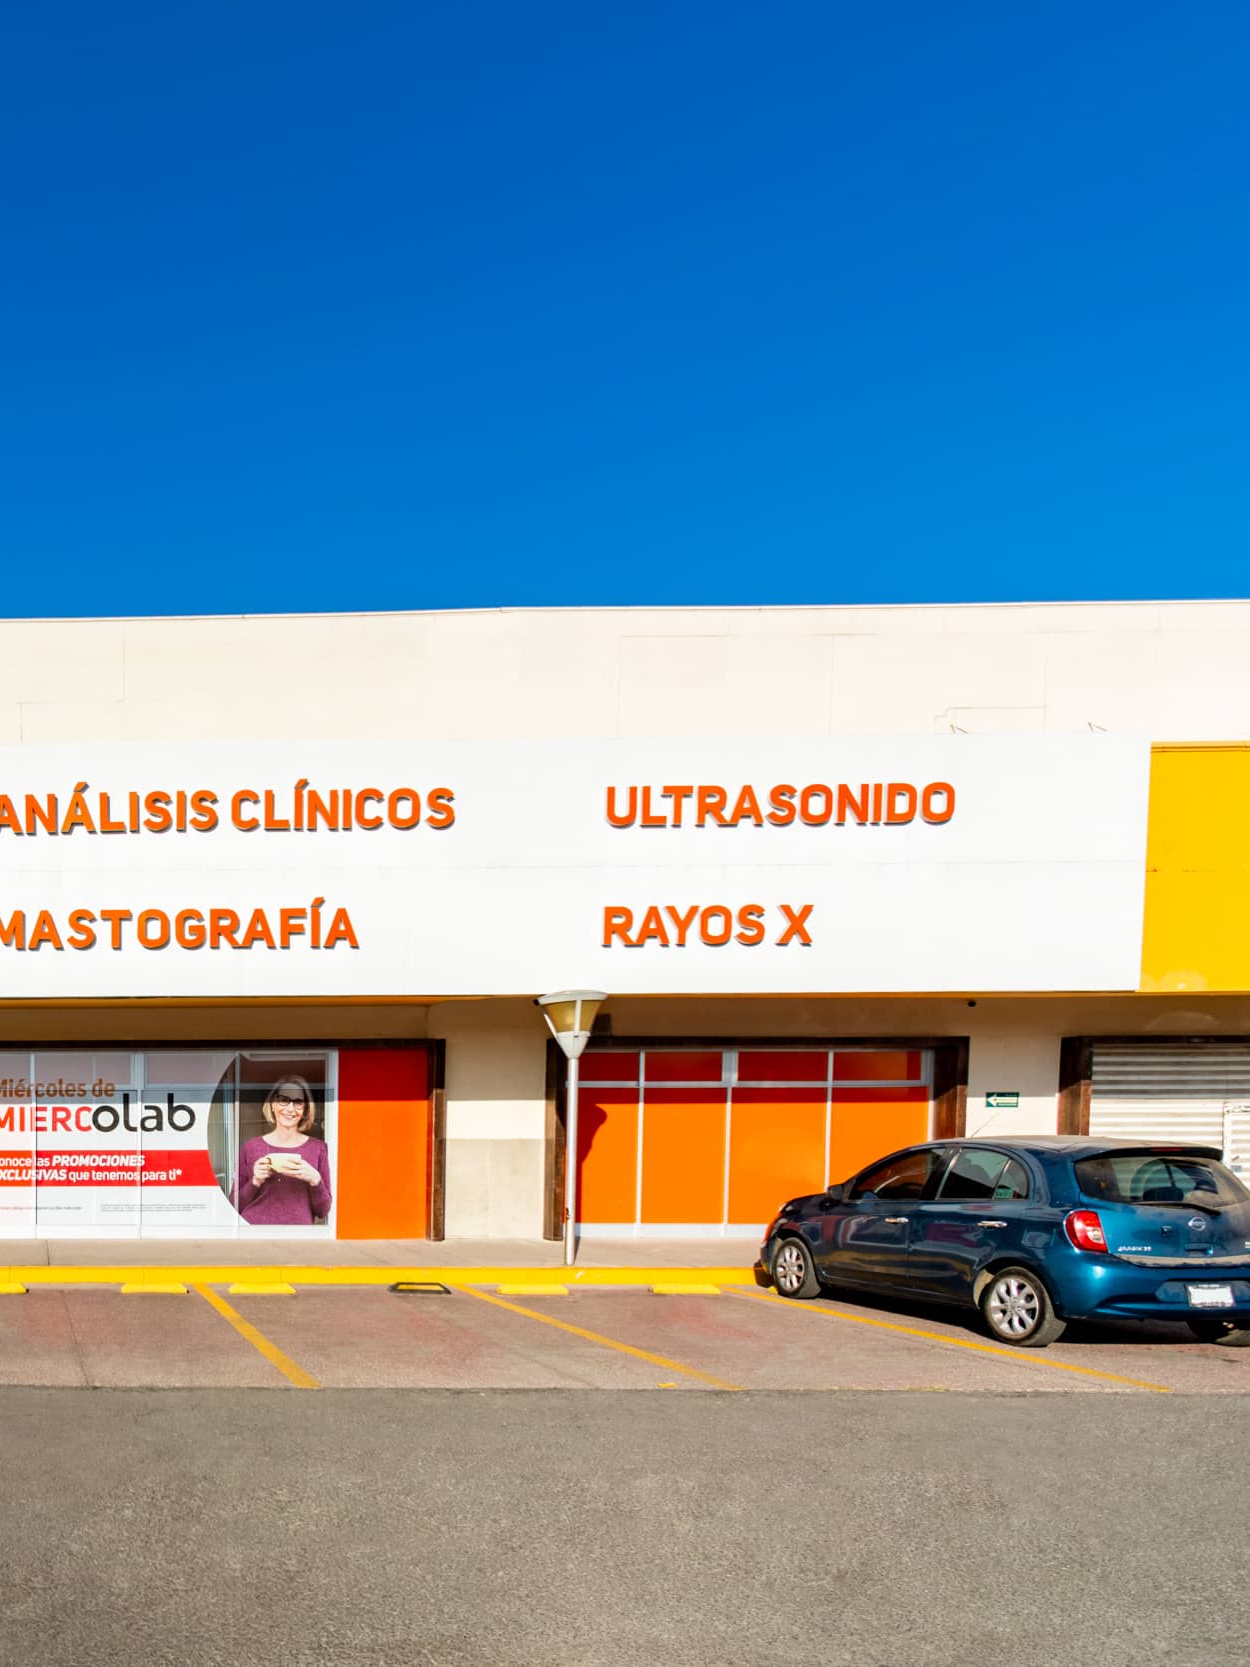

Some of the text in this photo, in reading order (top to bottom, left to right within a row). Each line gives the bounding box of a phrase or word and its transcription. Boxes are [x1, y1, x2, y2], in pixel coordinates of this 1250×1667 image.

[231, 778, 456, 833] CLÍNICOS
[605, 782, 956, 827] ULTRASONIDO
[602, 904, 814, 948] RAYOS X
[92, 1078, 115, 1097] de
[52, 1154, 145, 1167] PROMOCIONES
[68, 1171, 89, 1183] que
[91, 1169, 139, 1181] tenemos
[141, 1170, 166, 1183] para
